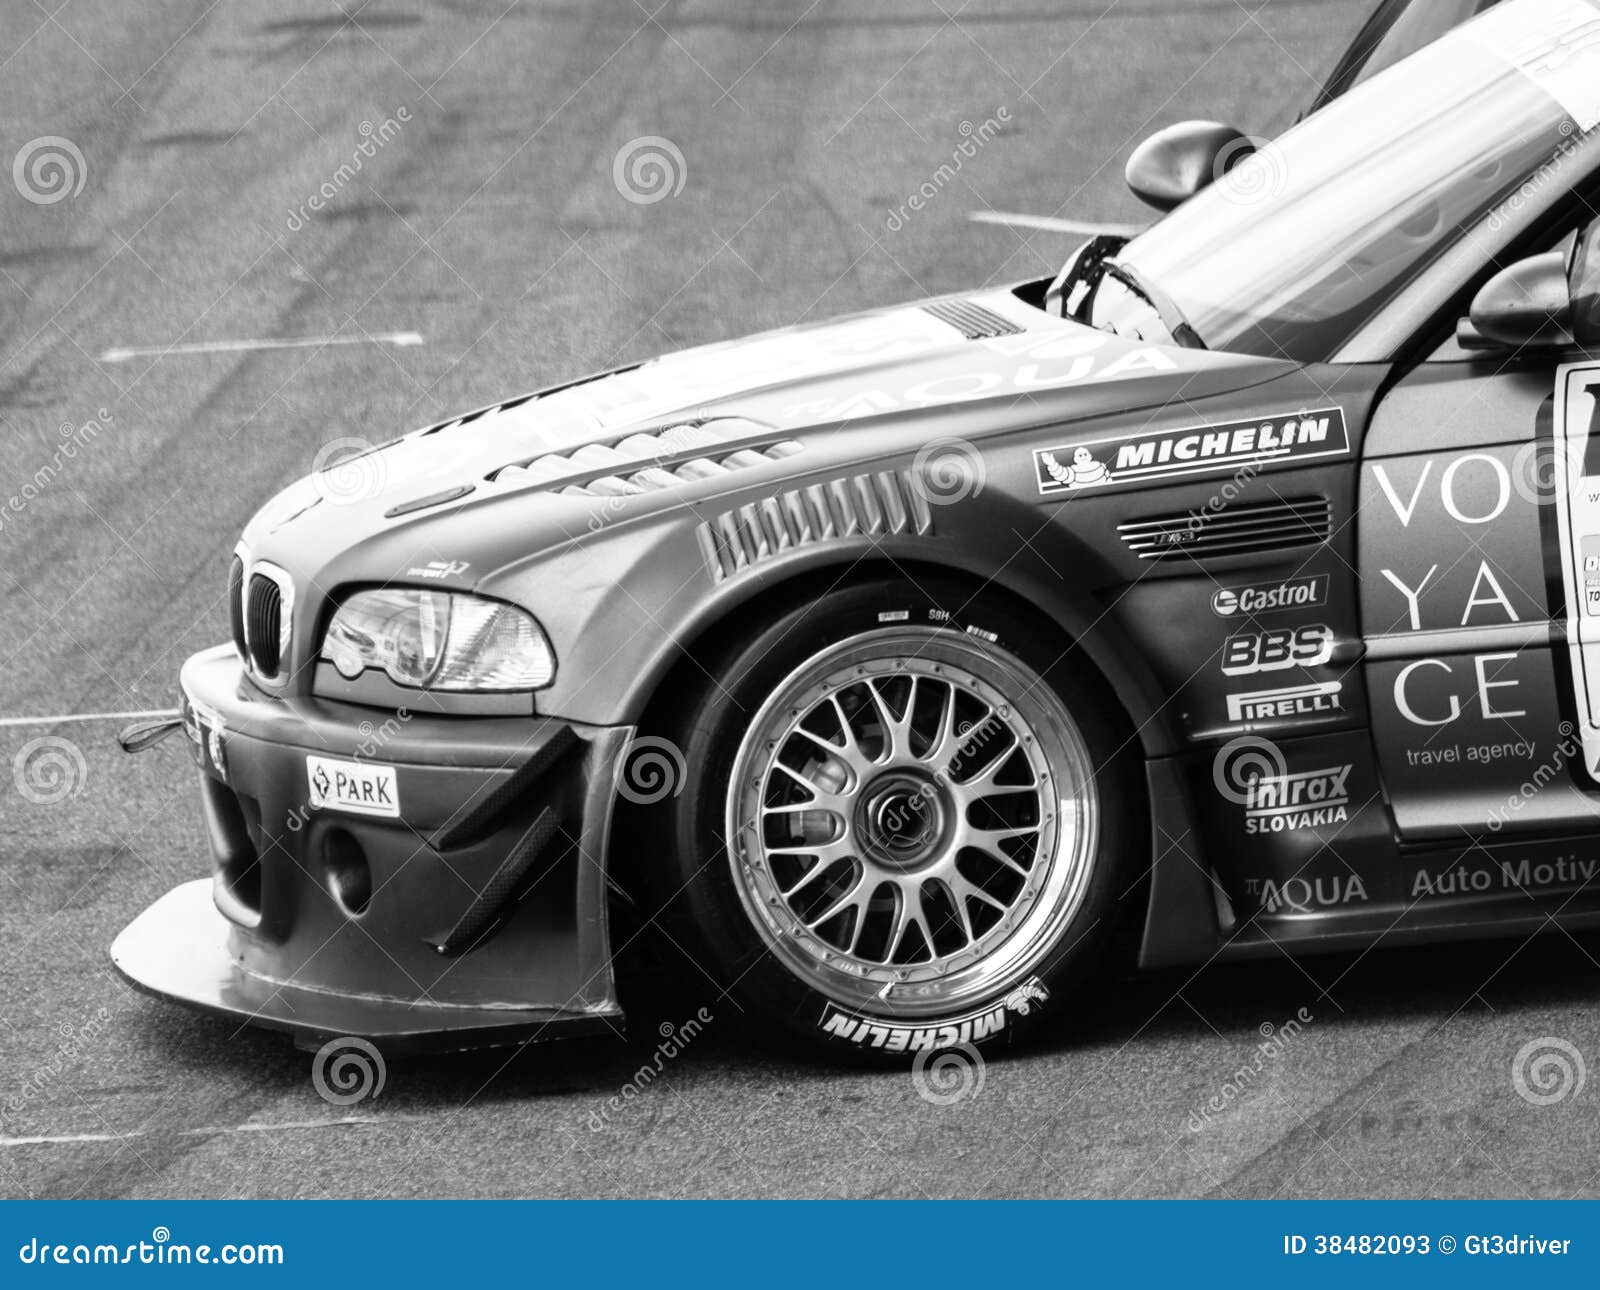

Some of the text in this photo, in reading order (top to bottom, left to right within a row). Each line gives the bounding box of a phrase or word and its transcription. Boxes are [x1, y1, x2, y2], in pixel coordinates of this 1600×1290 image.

[1116, 418, 1329, 469] MICHELIN
[1240, 580, 1317, 612] Castrol
[1221, 623, 1334, 676] BBS
[1226, 680, 1342, 721] PIRELLI
[1407, 741, 1535, 766] travel agency
[1245, 805, 1348, 834] SLOVAKIA
[1411, 855, 1596, 896] Auto Motiv
[823, 1008, 1005, 1051] MICHELIN
